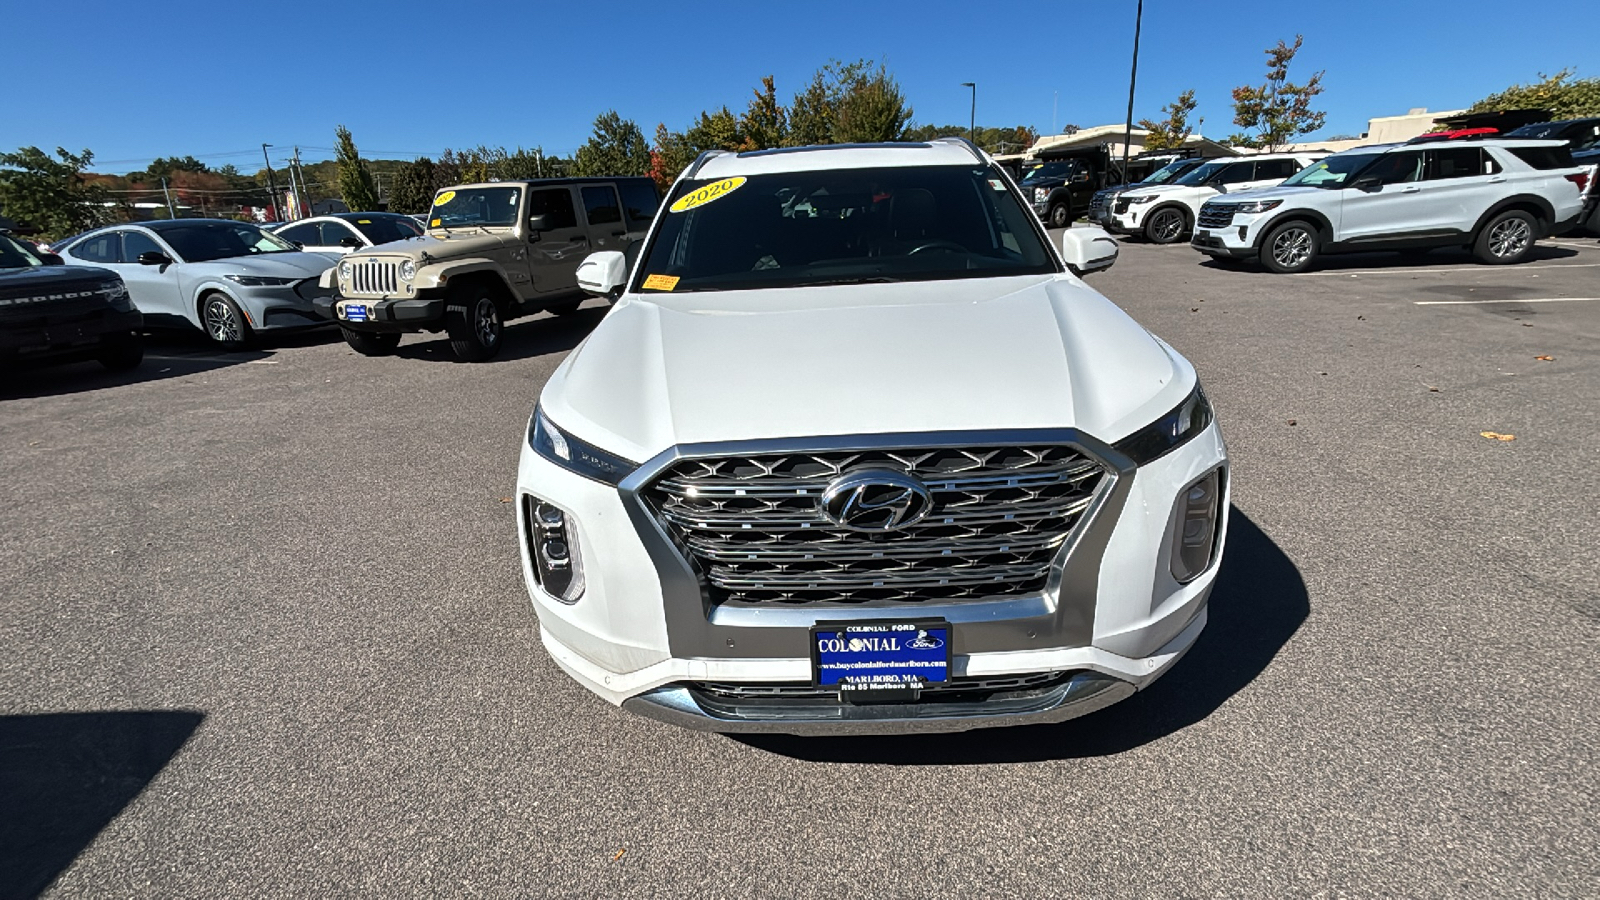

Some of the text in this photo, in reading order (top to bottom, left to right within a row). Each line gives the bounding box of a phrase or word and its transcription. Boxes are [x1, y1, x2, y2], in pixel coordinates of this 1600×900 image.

[684, 180, 733, 207] 2020
[846, 624, 916, 633] COLONIAL FORD
[818, 637, 901, 653] COLONIAL
[845, 674, 918, 683] MARLBORO, MA
[910, 682, 924, 690] MA
